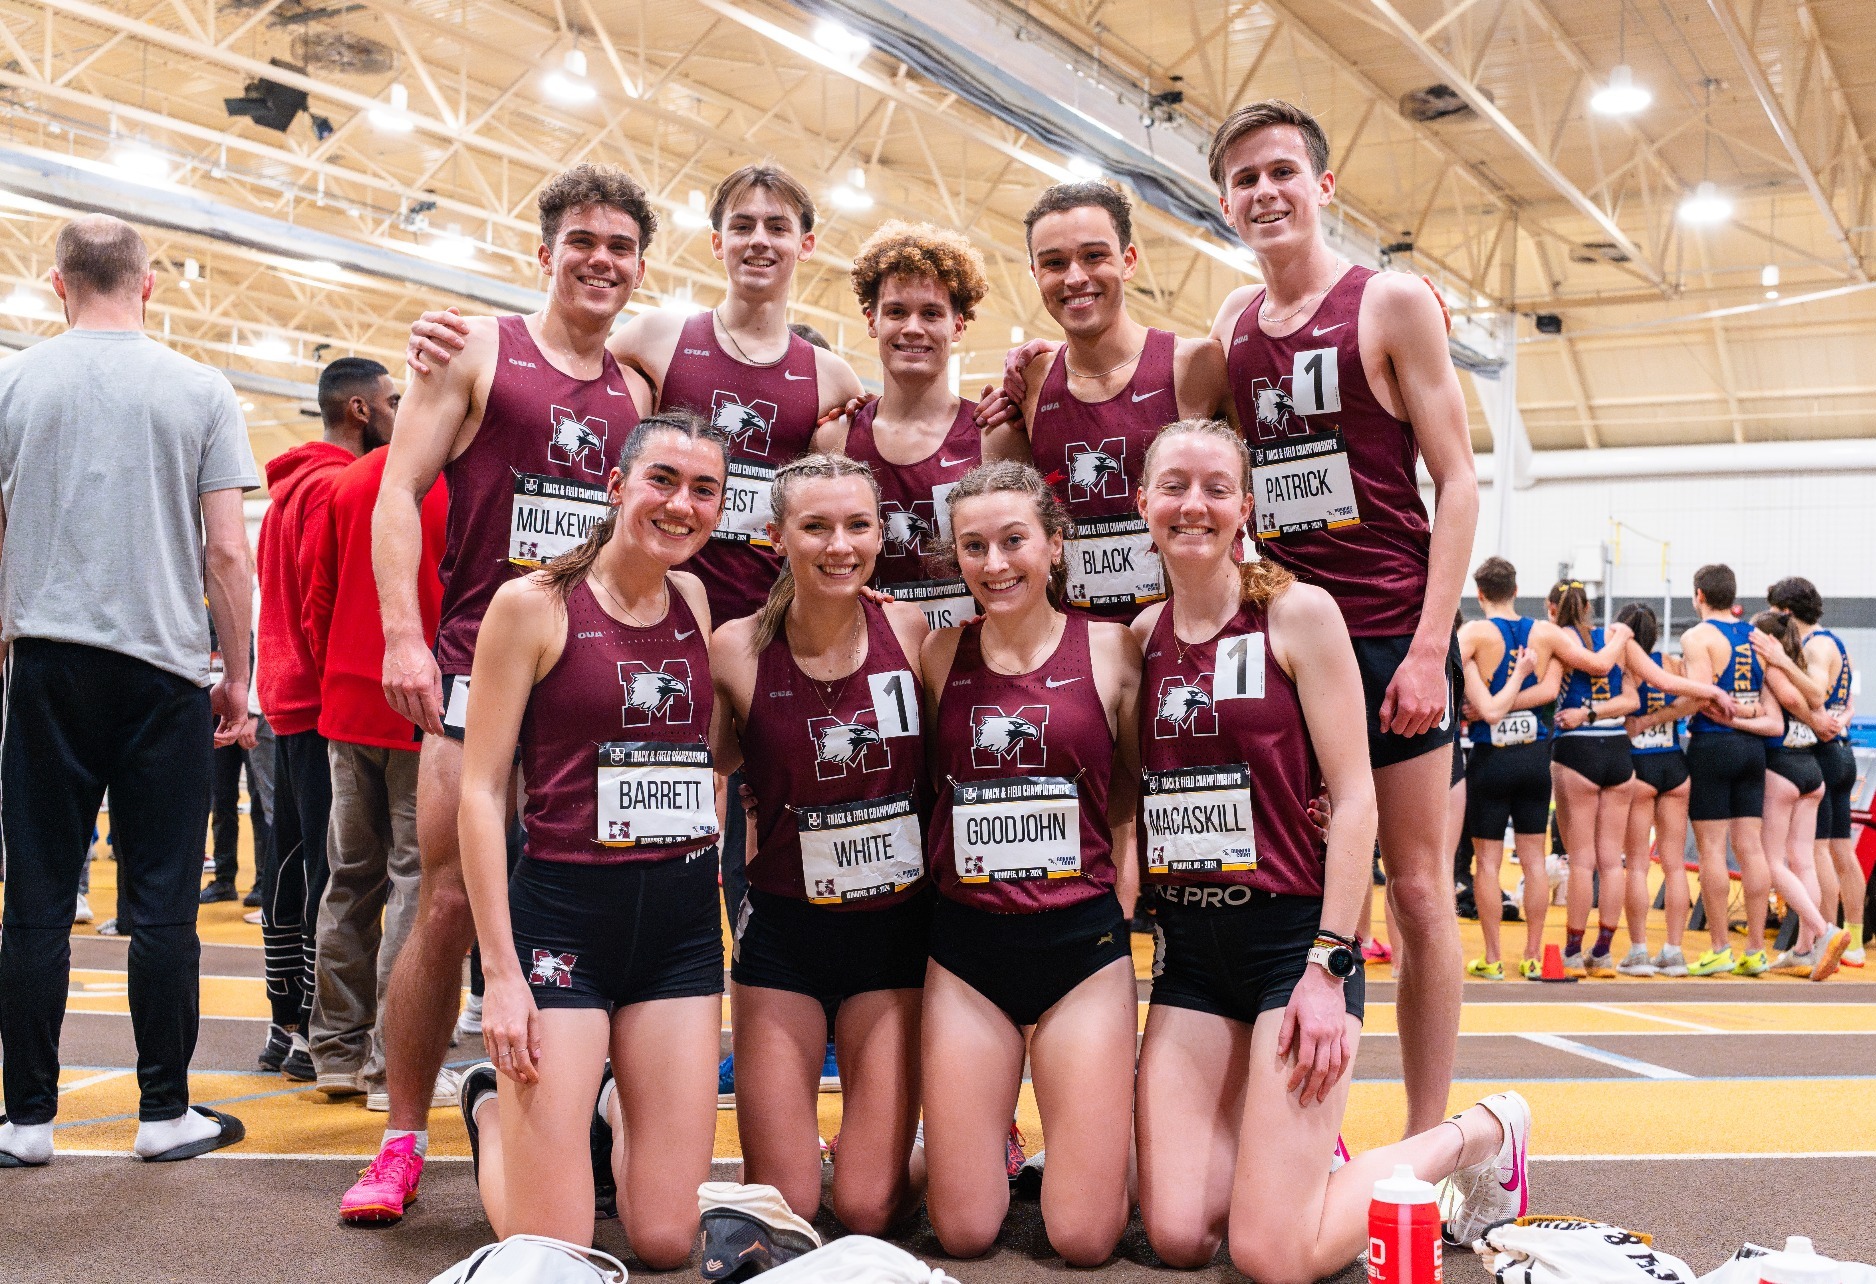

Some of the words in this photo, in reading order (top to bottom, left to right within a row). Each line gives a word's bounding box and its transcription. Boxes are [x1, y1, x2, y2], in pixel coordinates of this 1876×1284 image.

[684, 348, 710, 357] OUA
[509, 358, 537, 369] OUA
[1304, 353, 1325, 411] 1
[1041, 402, 1060, 412] OUA
[1266, 449, 1279, 460] TRACK
[543, 482, 560, 495] TRACK
[1266, 468, 1333, 503] PATRICK
[516, 506, 606, 539] MULKEW
[1078, 524, 1091, 536] TRACK
[1082, 546, 1135, 575] BLACK
[894, 588, 908, 599] TRACK
[924, 609, 952, 631] IUS
[577, 631, 603, 639] OUA
[1227, 638, 1248, 695] 1
[883, 675, 910, 733] 1
[1497, 719, 1530, 735] 449
[631, 750, 649, 762] TRACK
[1161, 777, 1175, 790] TRACK
[1196, 772, 1241, 787] CHAMPIONSHIPS
[619, 780, 702, 810] BARRETT
[982, 787, 1000, 800] TRACK
[1007, 785, 1021, 798] FIELD
[1022, 783, 1070, 797] CHAMPIONSHIPS
[827, 812, 846, 825] TRACK
[853, 809, 868, 822] FIELD
[869, 800, 910, 819] CHAMPIONSHIPS
[1149, 803, 1247, 837] MACASKILL
[966, 813, 1066, 845] GOODJOHN
[833, 833, 895, 868] WHITE
[1030, 869, 1043, 877] 2024
[1204, 860, 1217, 869] 2024
[1183, 884, 1251, 908] PRO
